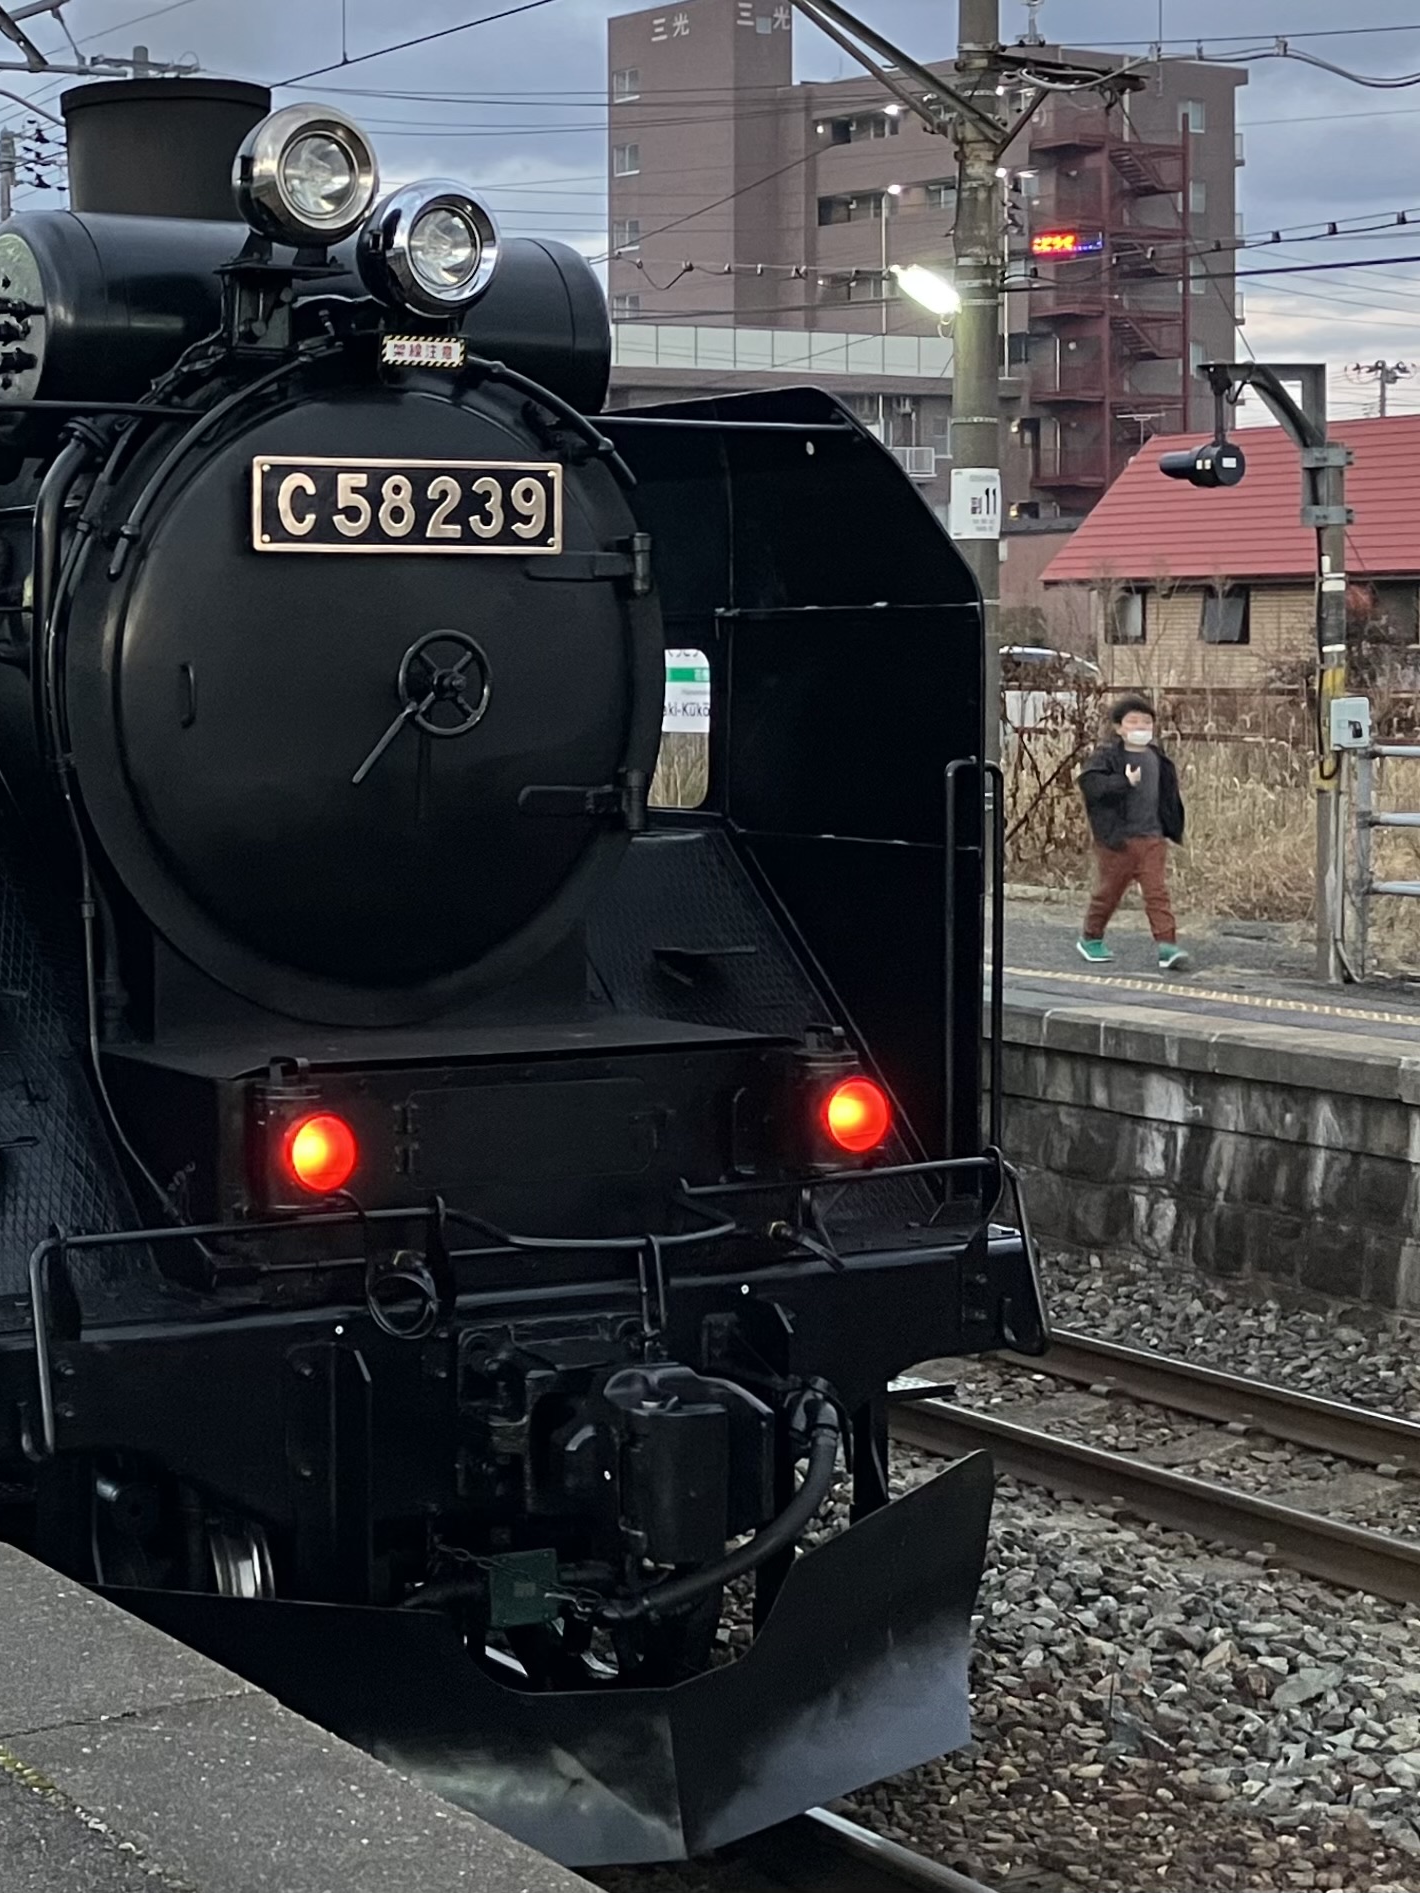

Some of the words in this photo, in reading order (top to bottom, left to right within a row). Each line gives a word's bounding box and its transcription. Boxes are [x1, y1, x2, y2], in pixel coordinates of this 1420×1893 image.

[651, 12, 690, 42] 三光
[736, 2, 791, 31] 三光
[277, 472, 547, 539] C58239
